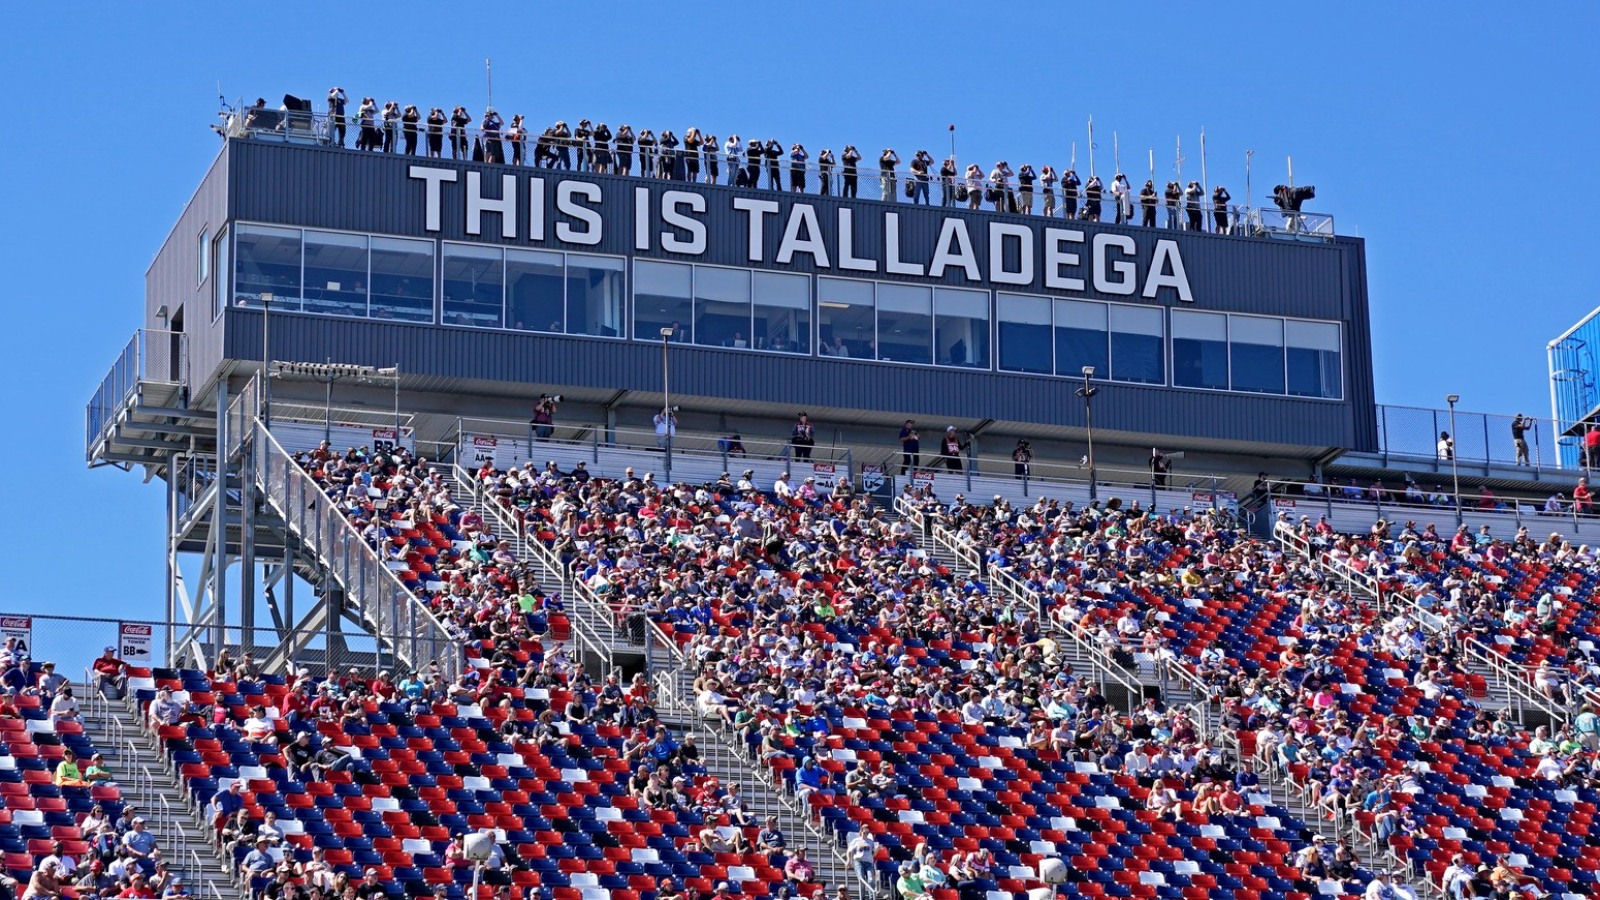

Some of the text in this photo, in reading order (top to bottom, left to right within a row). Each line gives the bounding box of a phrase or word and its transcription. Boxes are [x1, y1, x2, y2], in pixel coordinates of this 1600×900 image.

[409, 165, 1194, 302] THIS IS TALLADEGA
[475, 453, 485, 461] AA
[3, 619, 27, 627] Coca-Cola
[124, 626, 149, 634] Coca-Cola
[123, 646, 135, 656] BB
